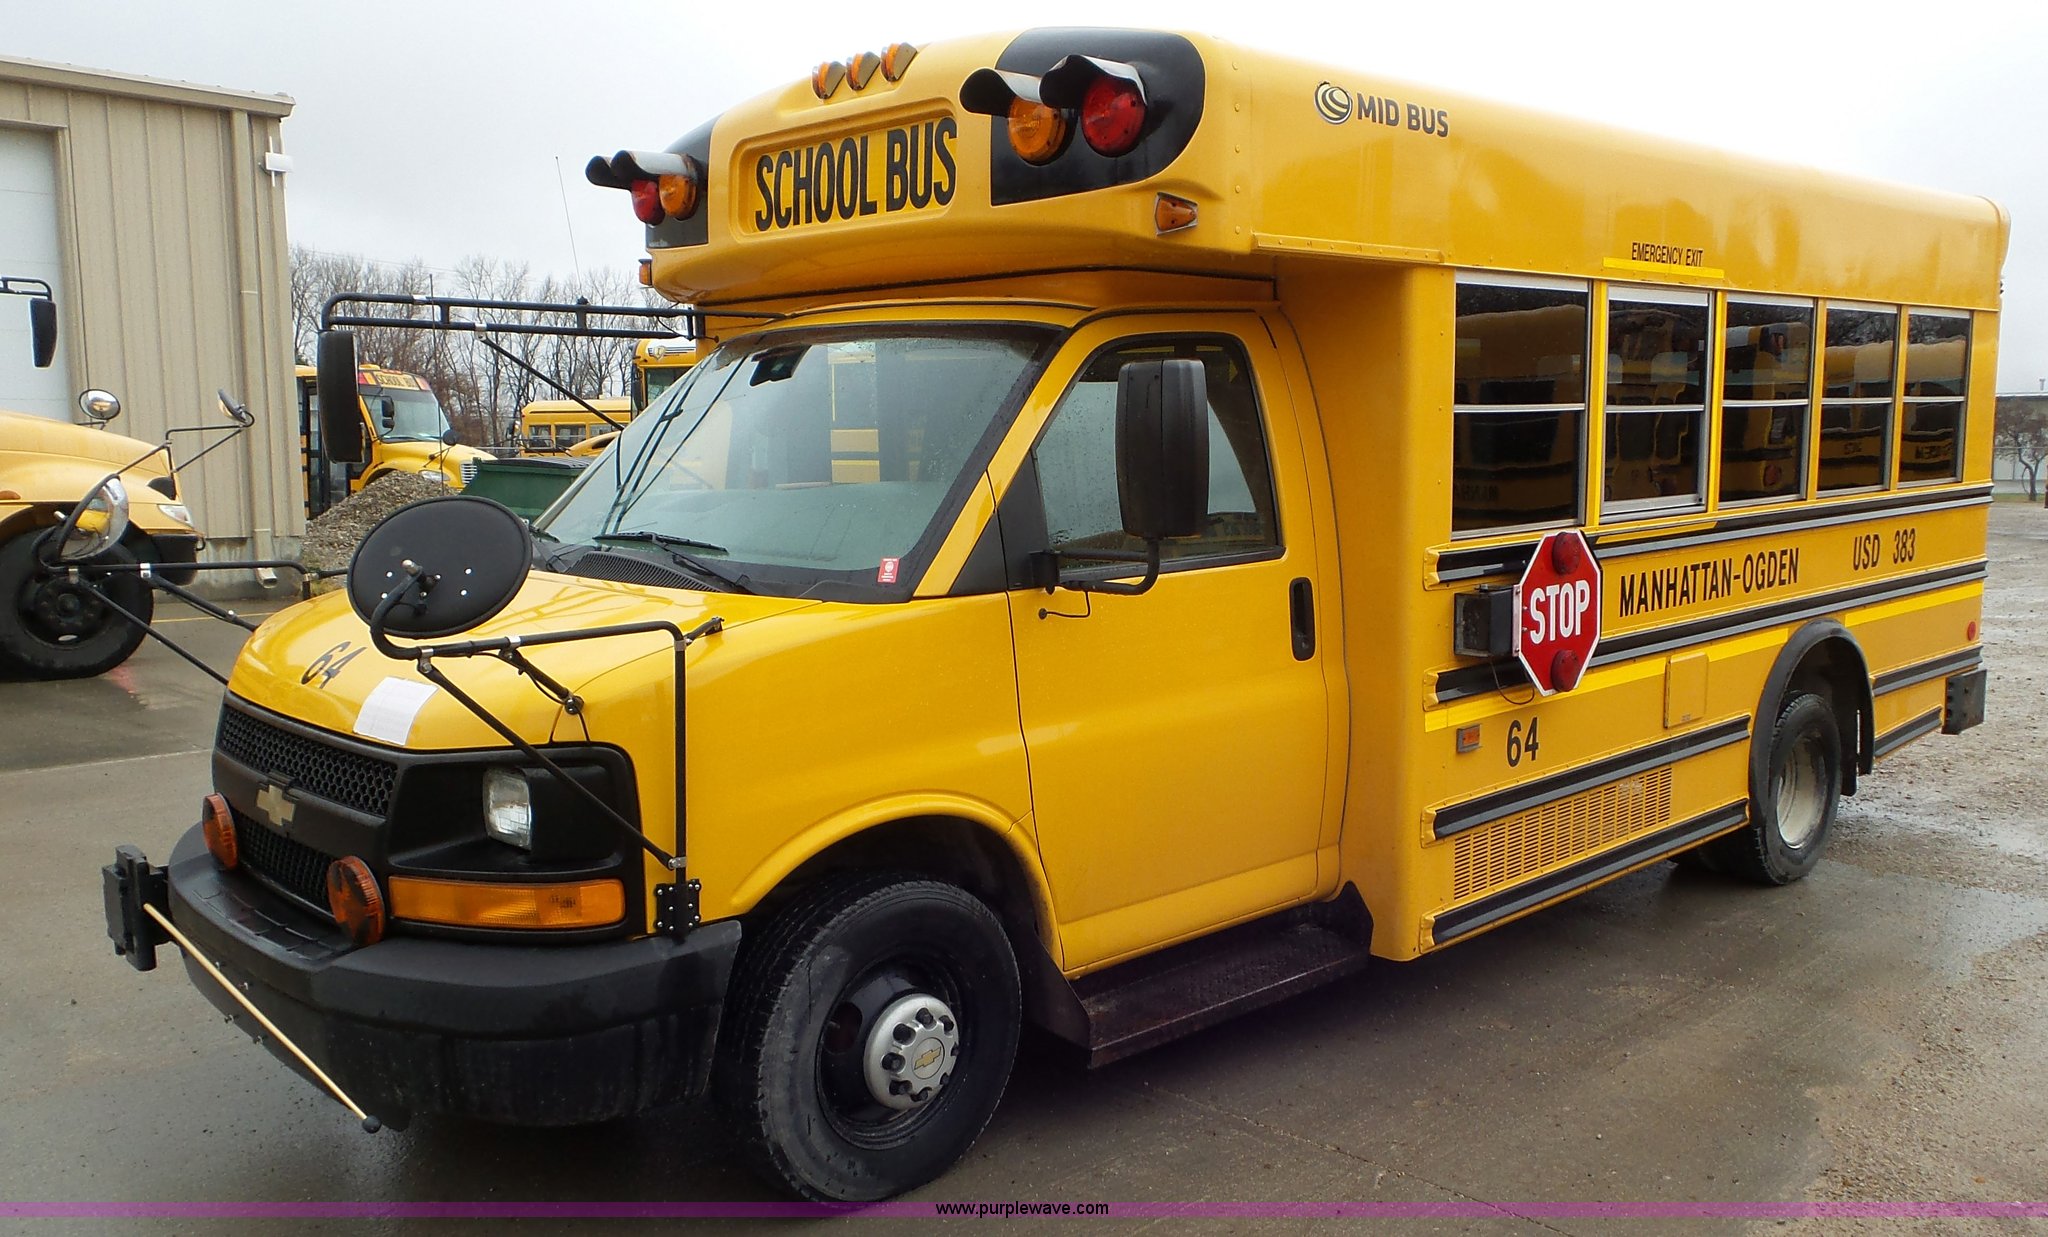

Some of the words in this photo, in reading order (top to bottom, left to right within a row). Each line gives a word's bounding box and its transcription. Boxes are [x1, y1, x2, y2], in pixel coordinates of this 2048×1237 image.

[1357, 93, 1399, 127] MID
[1408, 104, 1448, 138] BUS
[755, 136, 877, 231] SCHOOL
[886, 117, 957, 212] BUS
[1631, 242, 1682, 265] EMERGENCY
[1686, 249, 1703, 267] EXIT
[1619, 548, 1799, 617] MANHATTAN-OGDEN
[1852, 535, 1880, 572] USD
[1892, 528, 1916, 565] 383
[1529, 578, 1590, 645] STOP
[300, 640, 367, 689] 64
[1505, 716, 1539, 768] 64
